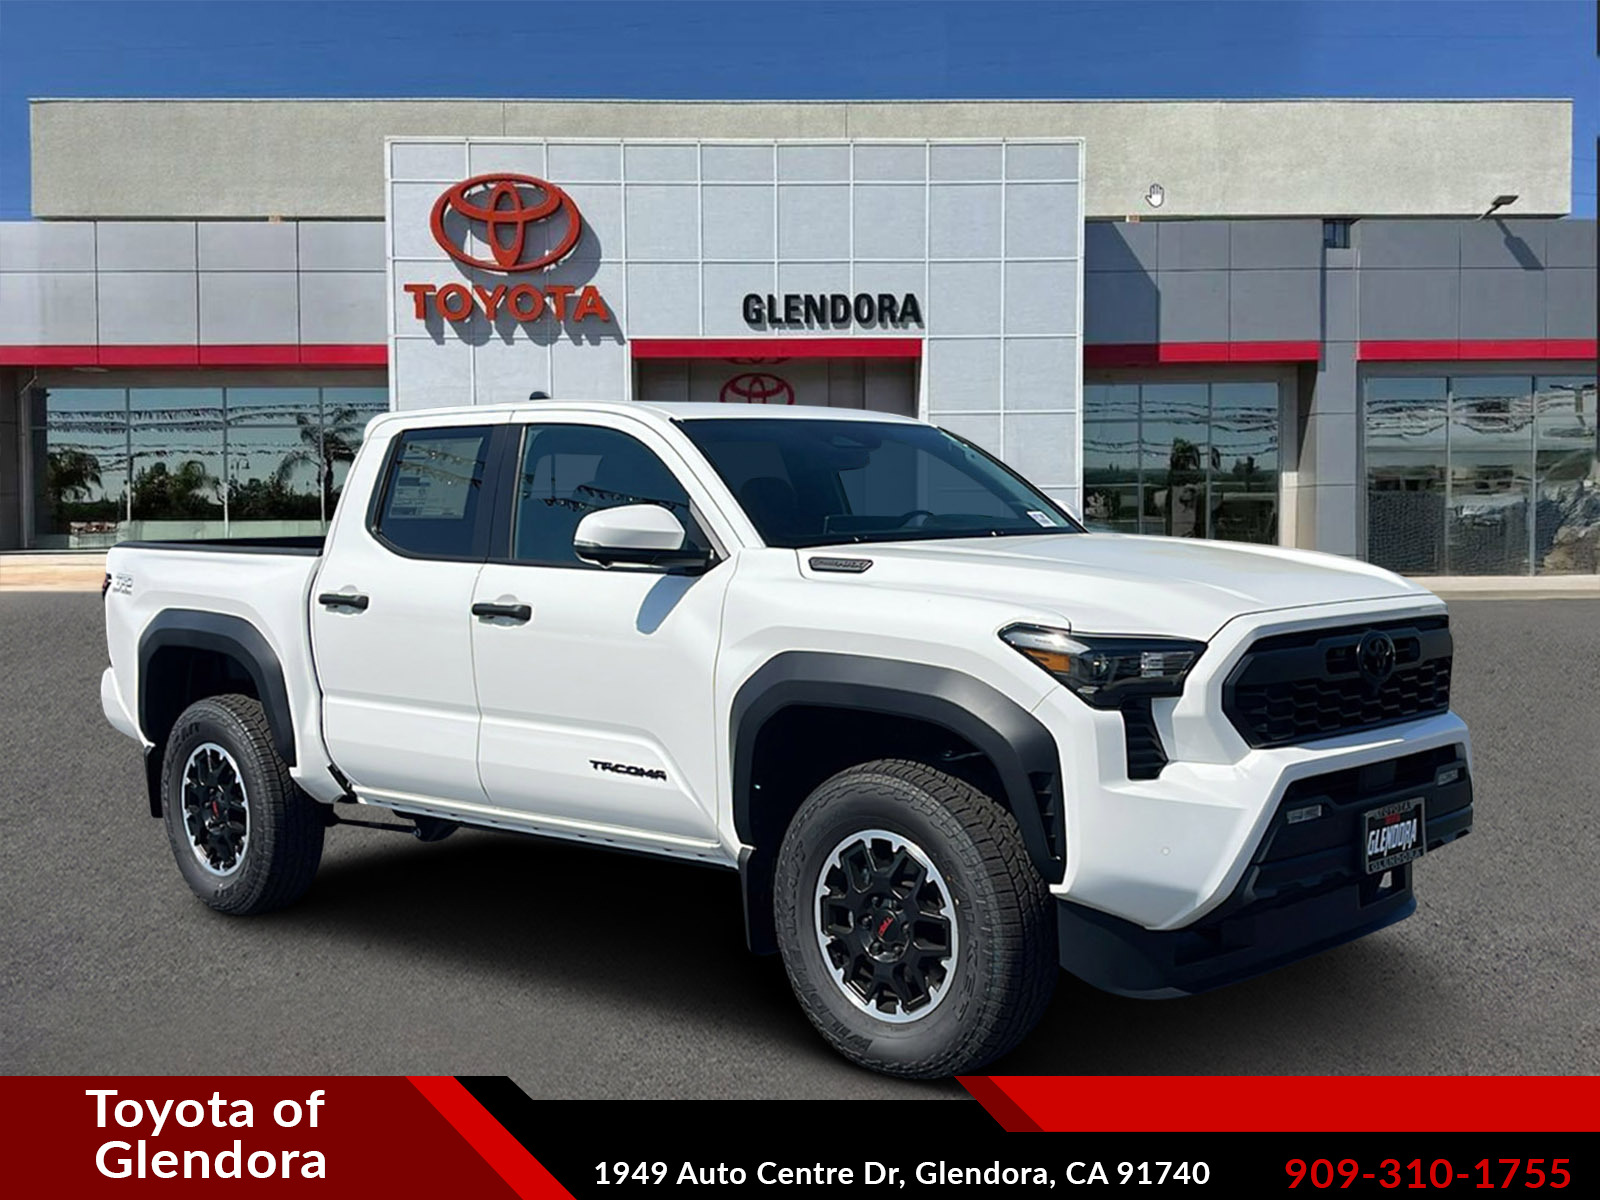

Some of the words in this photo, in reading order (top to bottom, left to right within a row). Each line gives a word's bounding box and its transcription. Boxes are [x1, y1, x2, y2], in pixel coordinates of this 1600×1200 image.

[403, 283, 611, 322] TOYOTA
[743, 293, 923, 326] GLENDORA
[589, 760, 667, 781] TACOMA
[1368, 818, 1417, 856] GLENDORA
